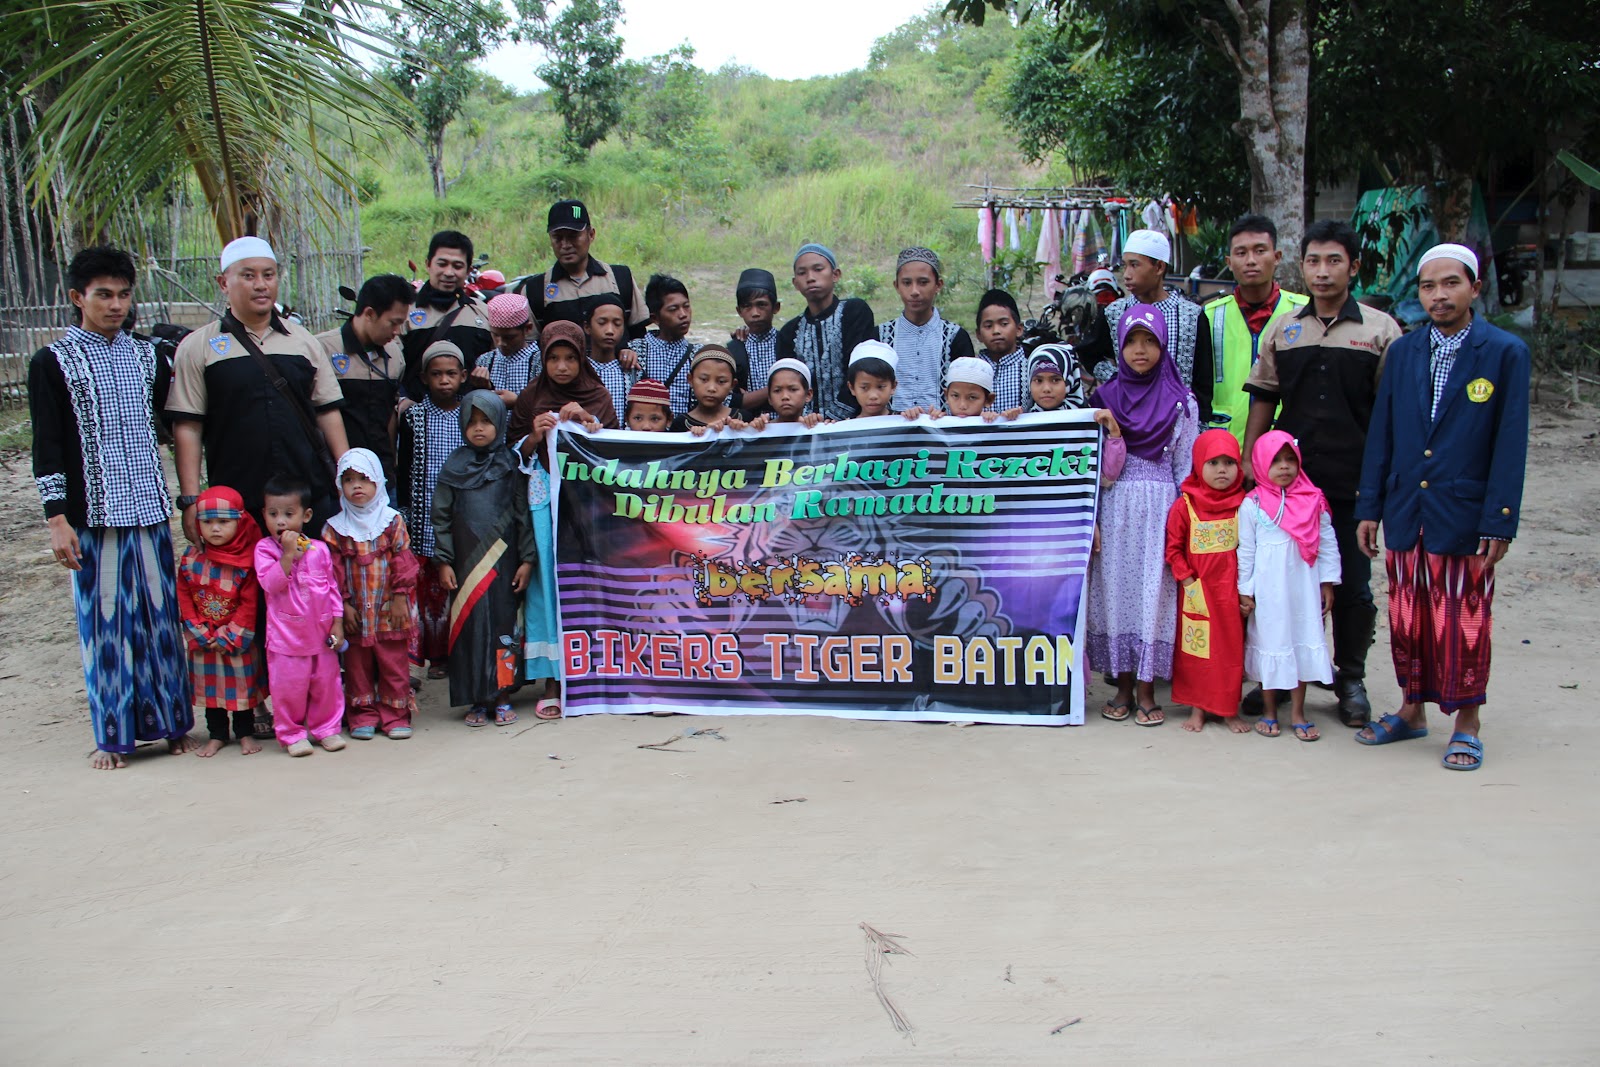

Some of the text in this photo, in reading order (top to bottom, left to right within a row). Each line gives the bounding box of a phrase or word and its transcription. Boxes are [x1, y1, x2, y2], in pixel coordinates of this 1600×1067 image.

[557, 446, 1093, 498] Indahnya Berbagi Rezeki
[612, 484, 997, 524] Dibulan Ramadan
[696, 553, 932, 605] bersama
[563, 629, 743, 681] BIKERS
[764, 632, 913, 682] TIGER
